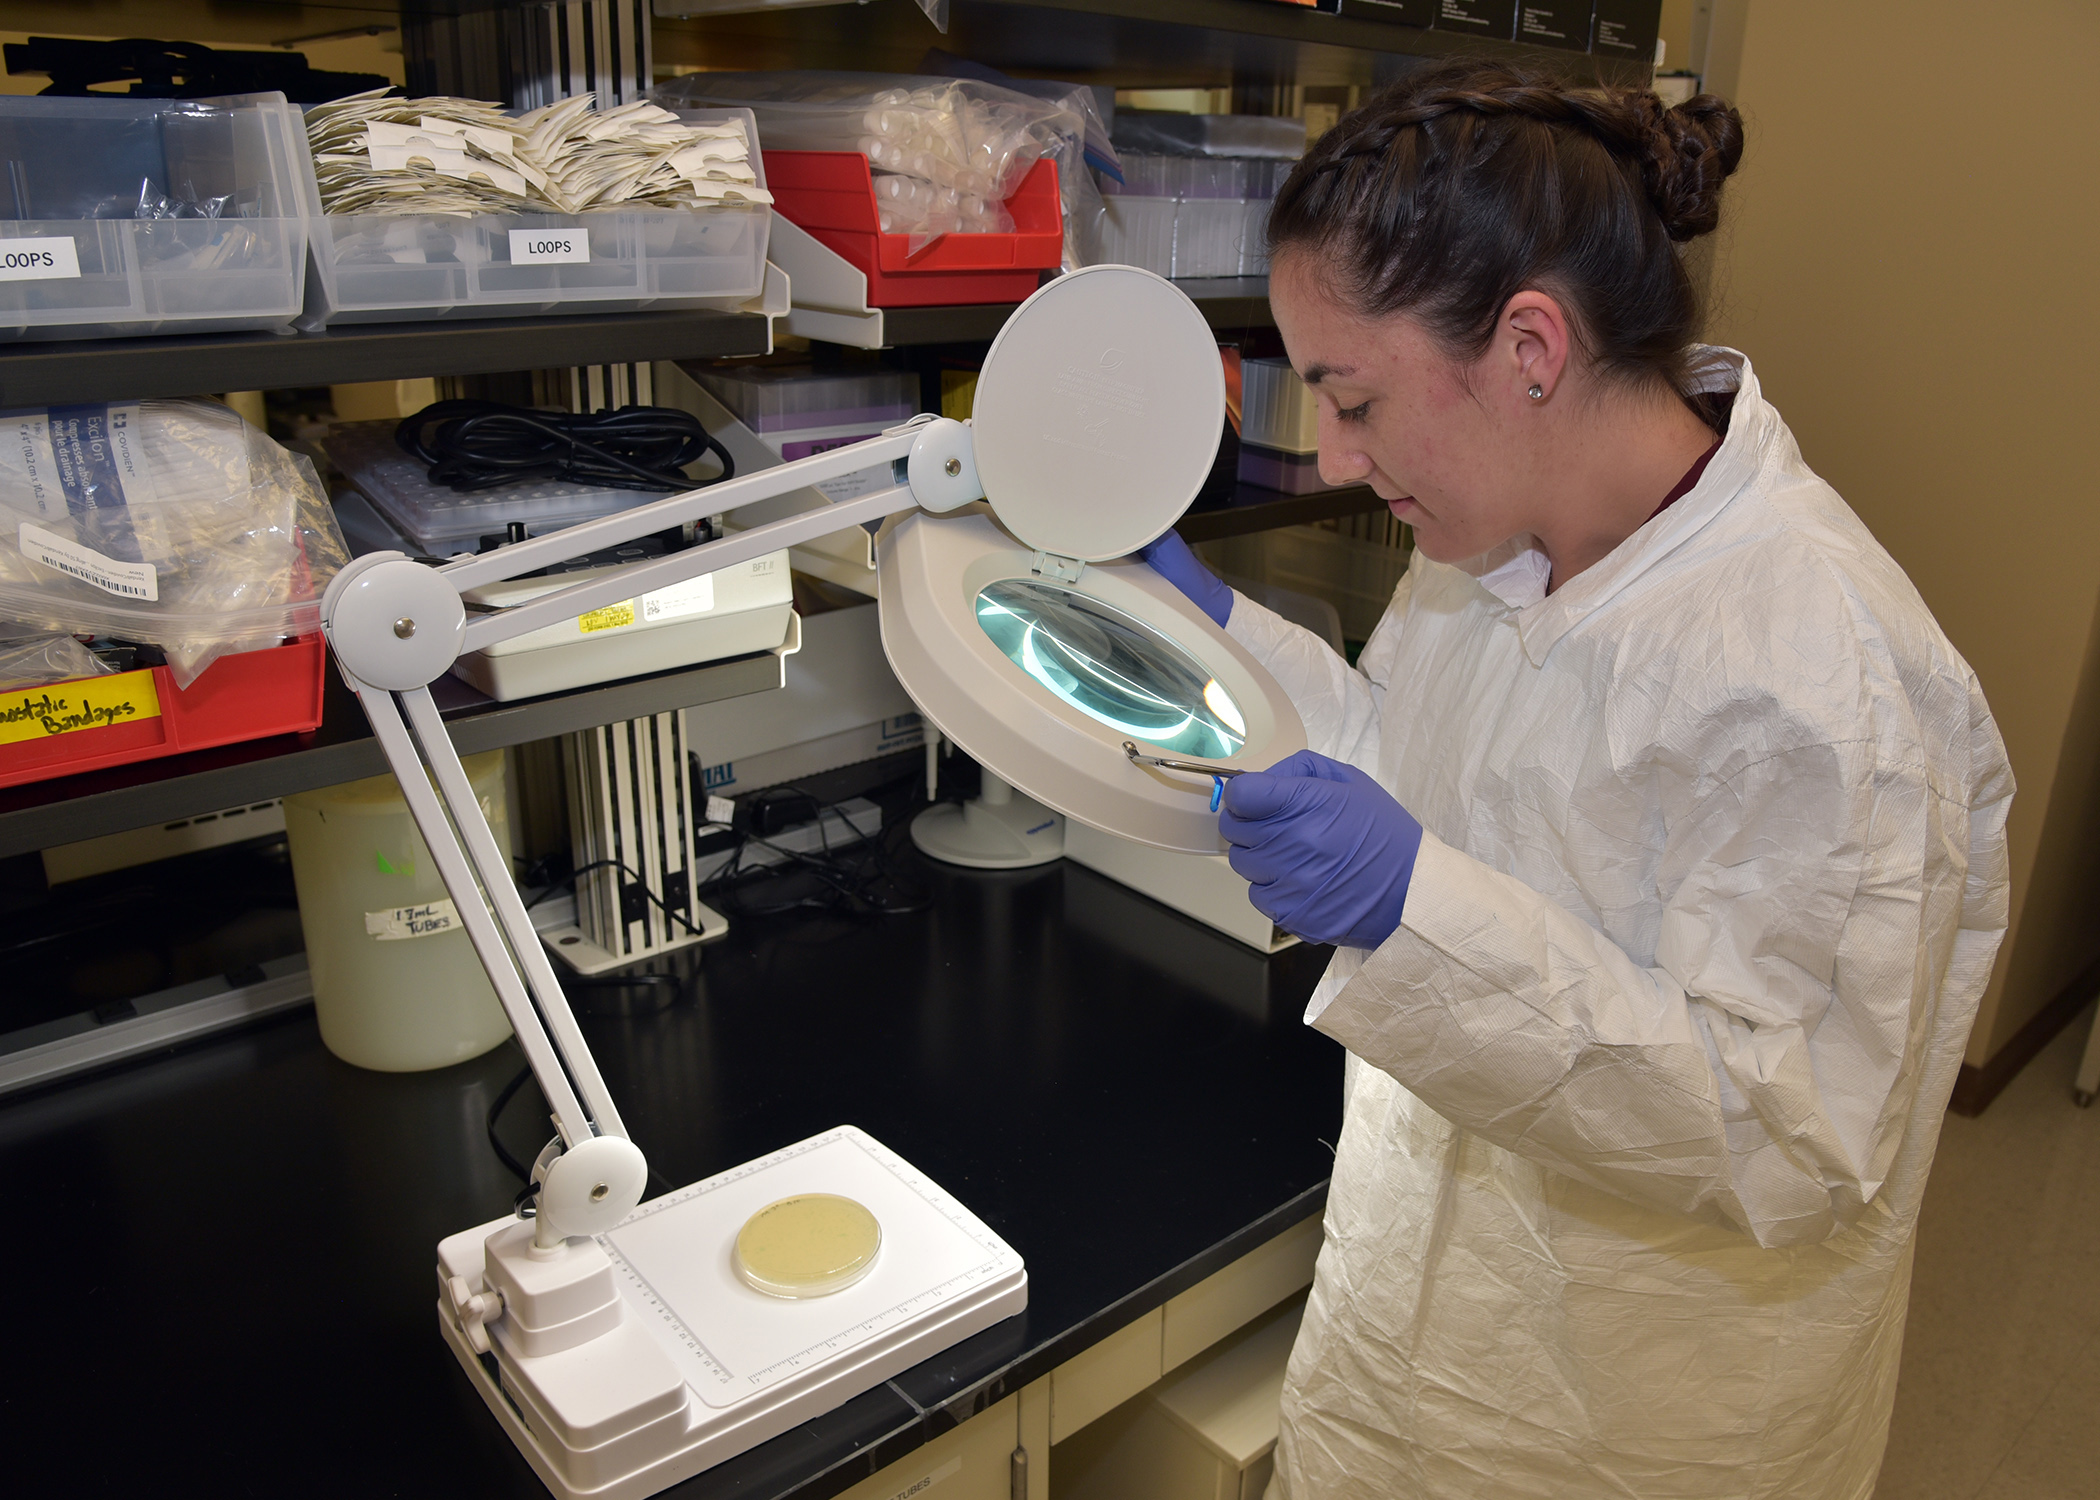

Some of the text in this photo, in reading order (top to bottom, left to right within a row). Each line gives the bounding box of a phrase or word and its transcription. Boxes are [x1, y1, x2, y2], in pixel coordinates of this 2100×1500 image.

[528, 240, 571, 254] LOOPS
[68, 418, 85, 465] Compresses
[52, 420, 63, 437] pour
[59, 447, 76, 487] drainage
[28, 465, 38, 478] cm
[752, 561, 767, 572] BFT
[40, 699, 136, 735] Bandages
[405, 916, 451, 935] TUBES
[896, 1477, 931, 1500] TUBES
